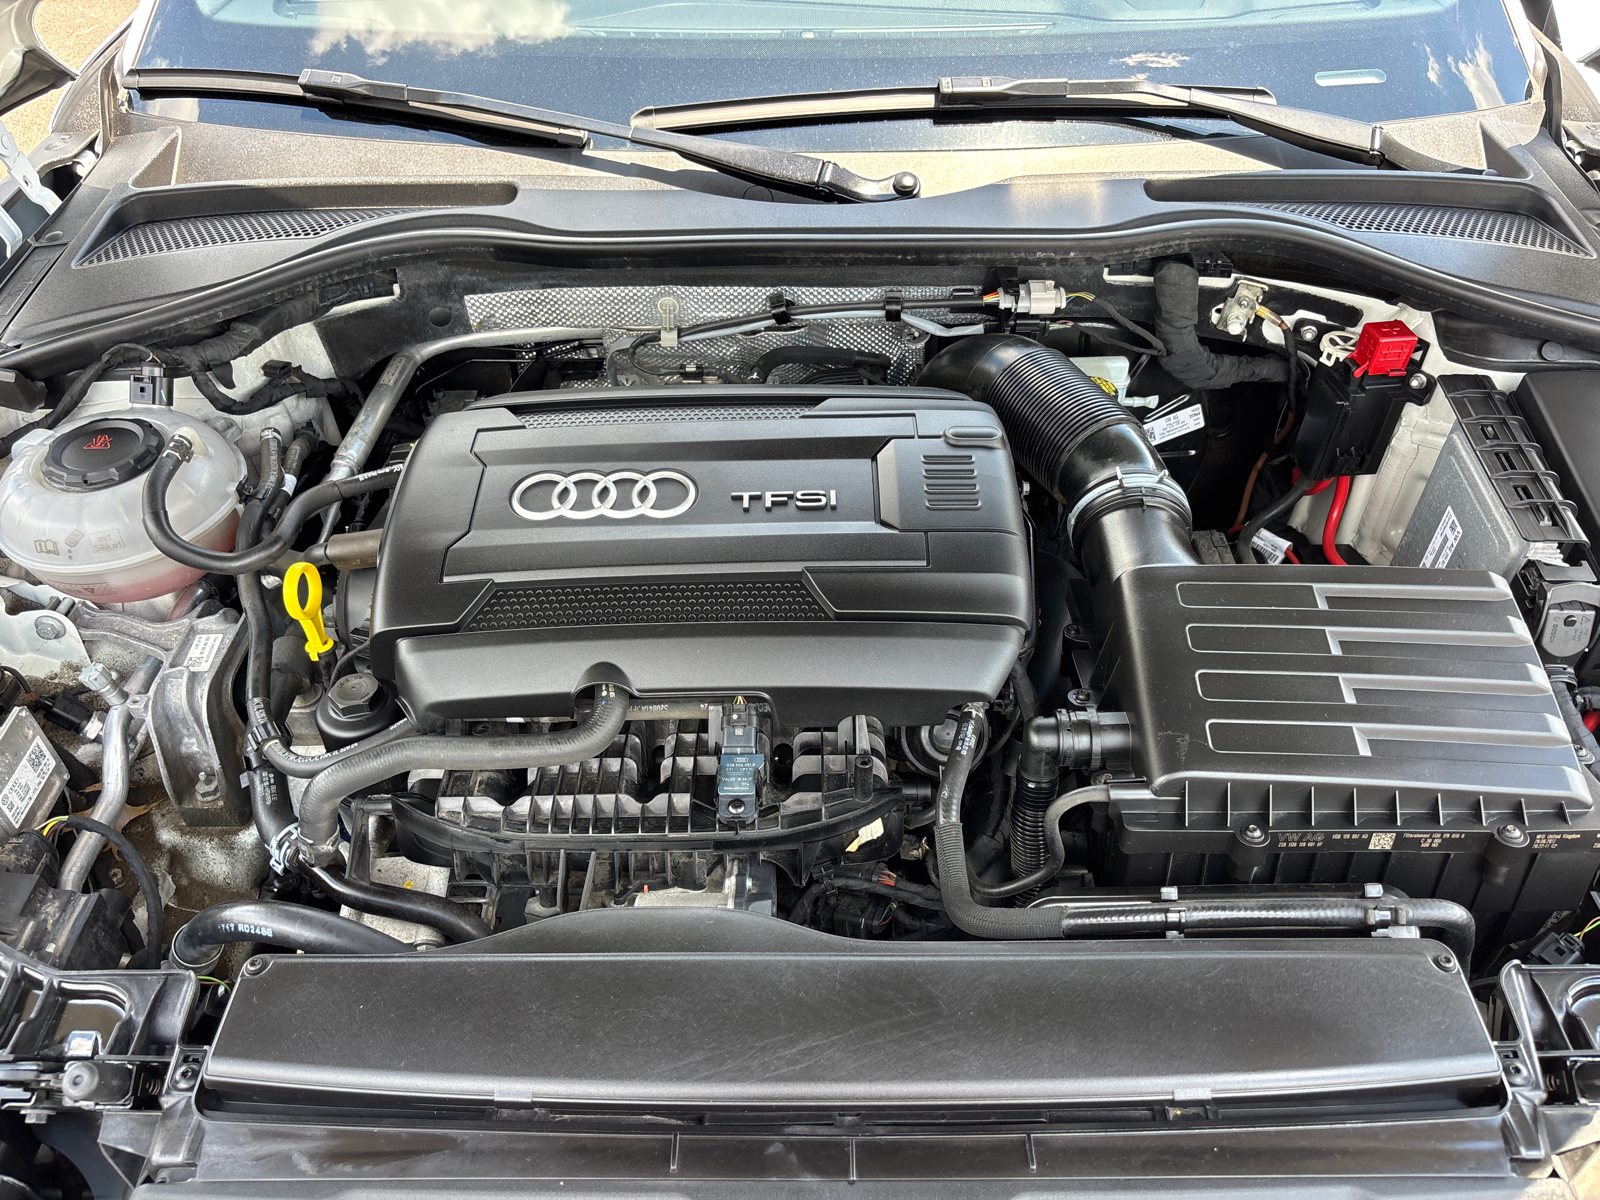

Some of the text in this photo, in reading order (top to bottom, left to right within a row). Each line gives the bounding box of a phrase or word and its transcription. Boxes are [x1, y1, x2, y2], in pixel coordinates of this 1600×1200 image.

[731, 489, 837, 511] TFSI
[98, 534, 112, 542] mit
[93, 541, 124, 552] Silikat
[1549, 624, 1558, 643] BOSCH
[1277, 833, 1325, 842] VW AG
